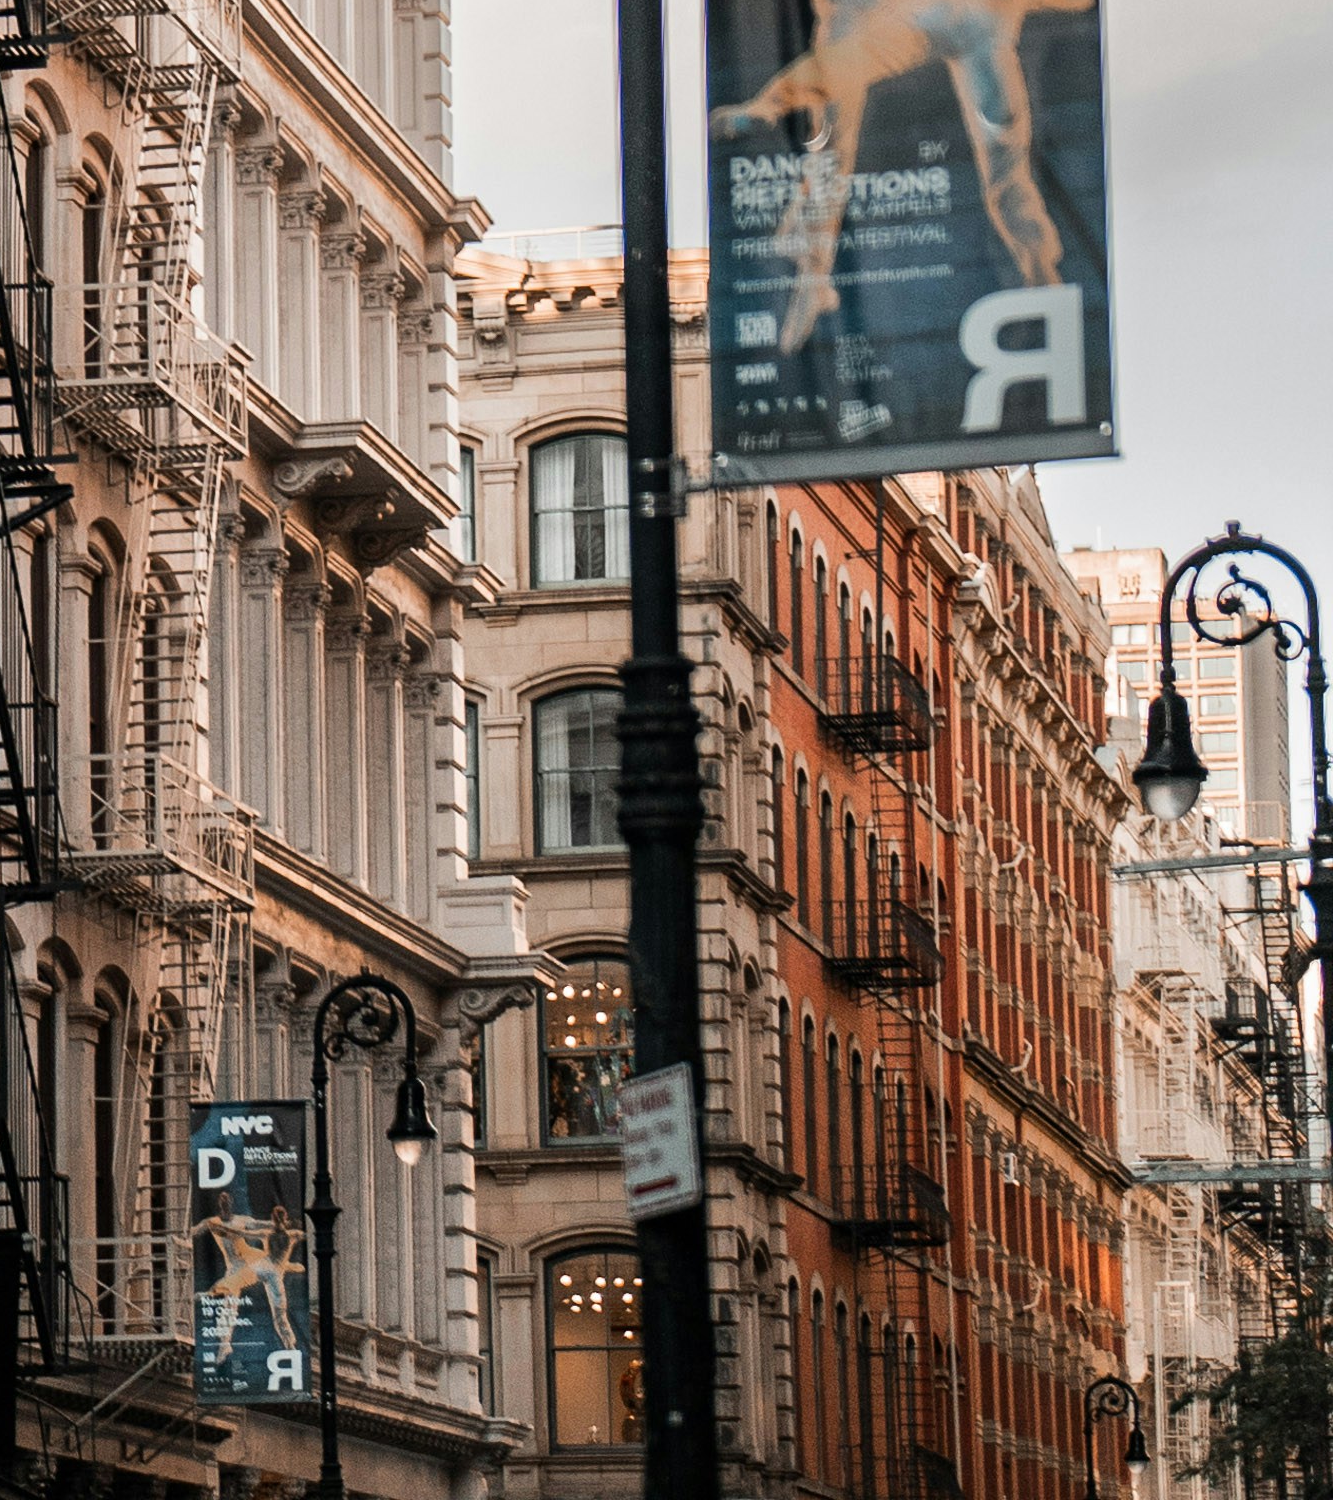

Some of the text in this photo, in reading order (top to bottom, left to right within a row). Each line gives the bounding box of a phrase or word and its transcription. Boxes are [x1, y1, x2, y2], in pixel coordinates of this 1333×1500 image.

[730, 149, 837, 181] DANCE
[221, 1115, 273, 1135] NYC
[198, 1147, 236, 1188] D
